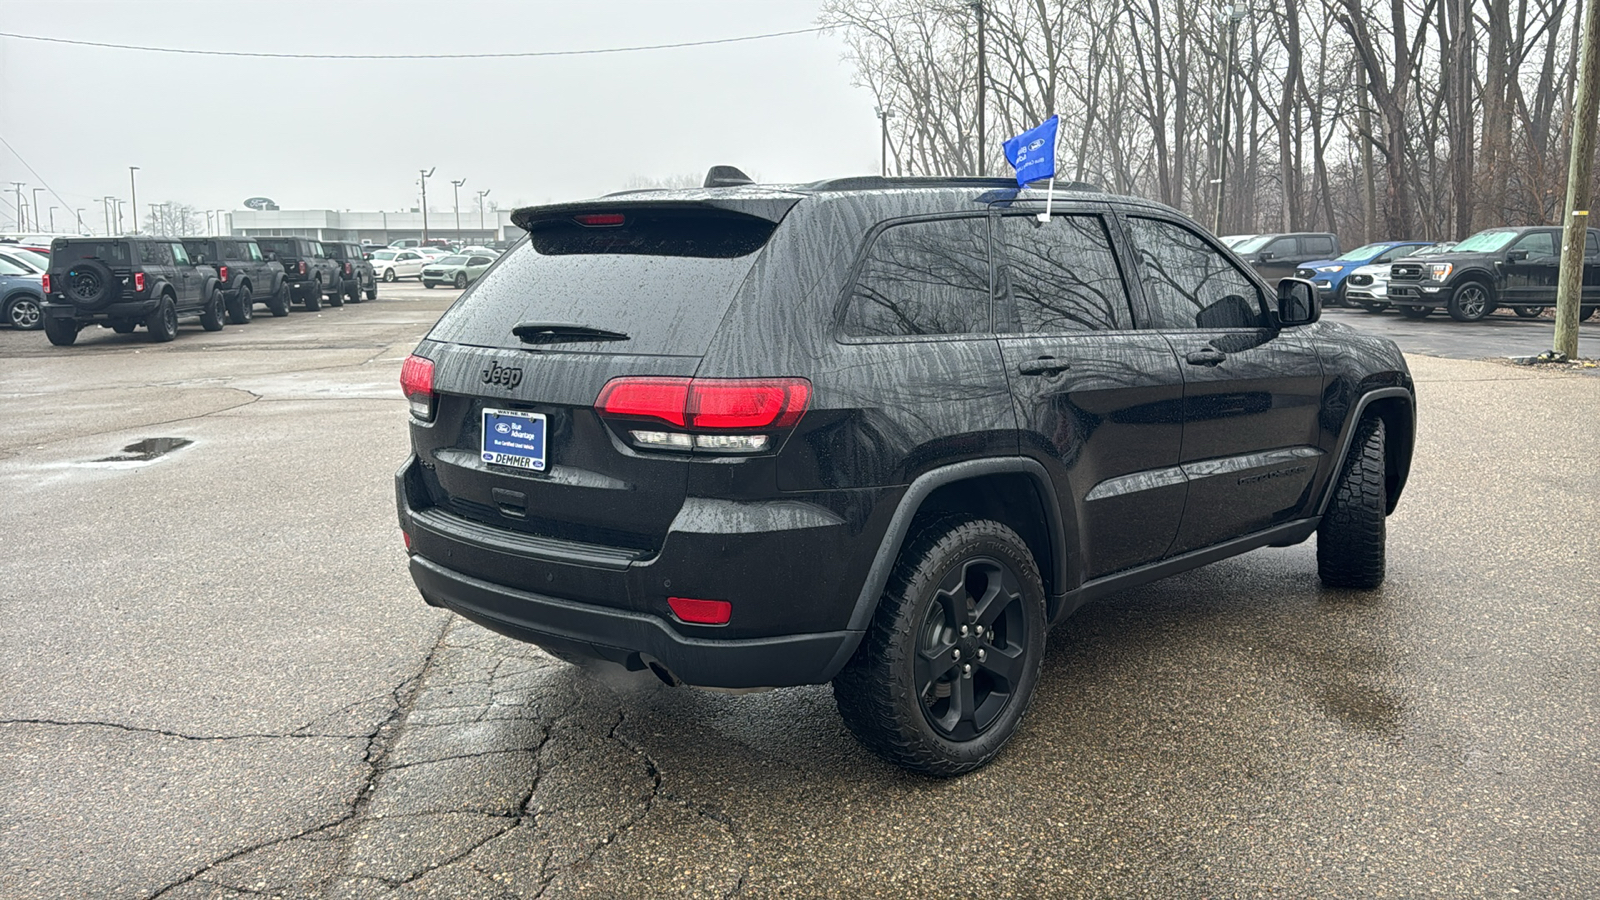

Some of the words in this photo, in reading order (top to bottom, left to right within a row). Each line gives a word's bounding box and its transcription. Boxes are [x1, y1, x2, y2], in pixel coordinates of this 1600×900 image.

[482, 361, 523, 390] Jeep
[511, 423, 521, 431] Blue
[511, 431, 535, 440] Advantage
[495, 453, 531, 467] DEMMER
